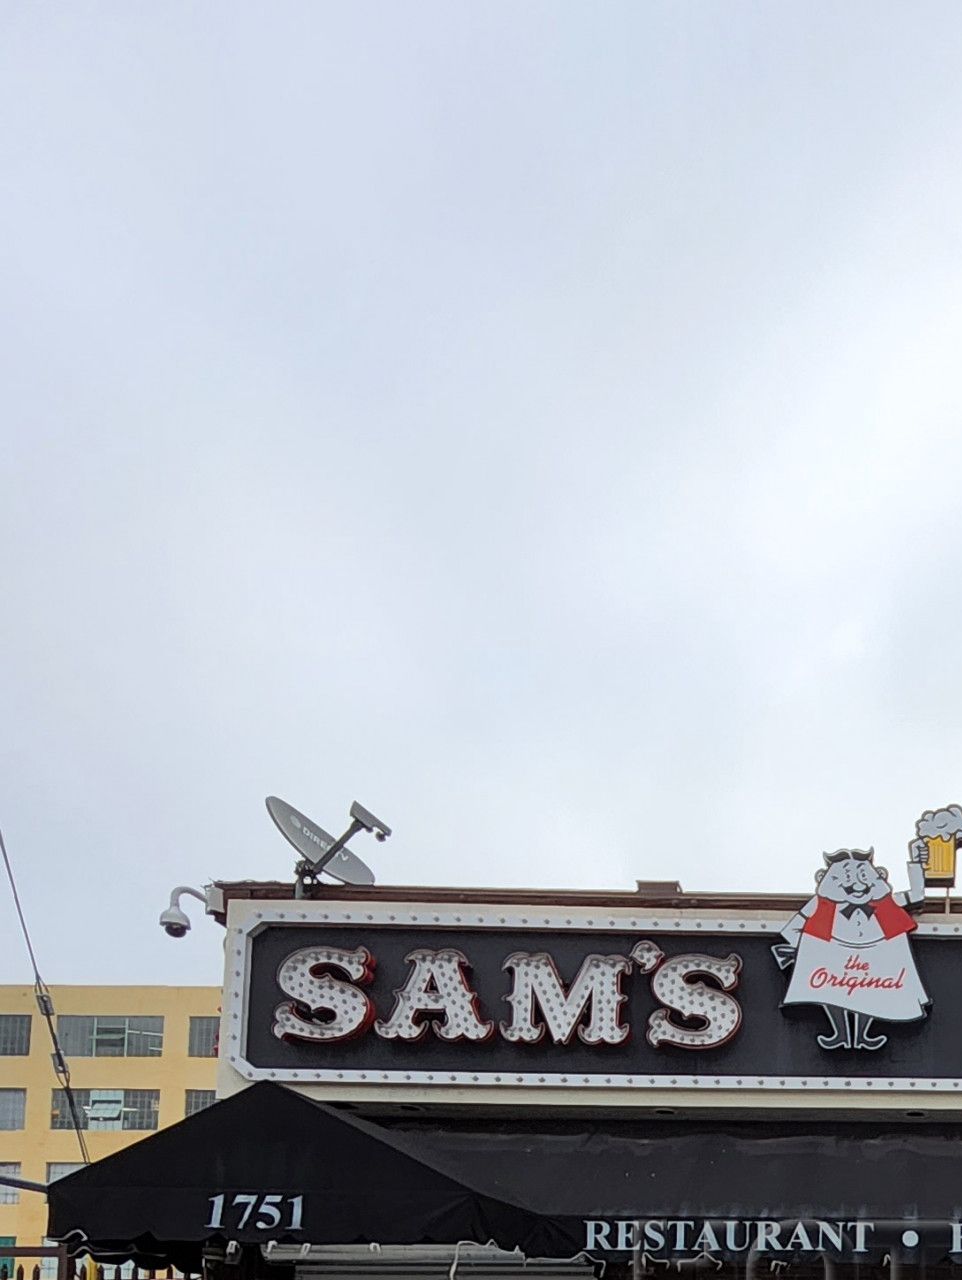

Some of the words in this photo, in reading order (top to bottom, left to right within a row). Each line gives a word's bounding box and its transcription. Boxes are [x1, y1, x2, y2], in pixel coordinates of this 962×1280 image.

[844, 954, 870, 971] the
[272, 940, 742, 1050] SAM'S
[809, 967, 905, 996] Original
[203, 1194, 305, 1231] 1751
[583, 1219, 875, 1253] RESTAURANT
